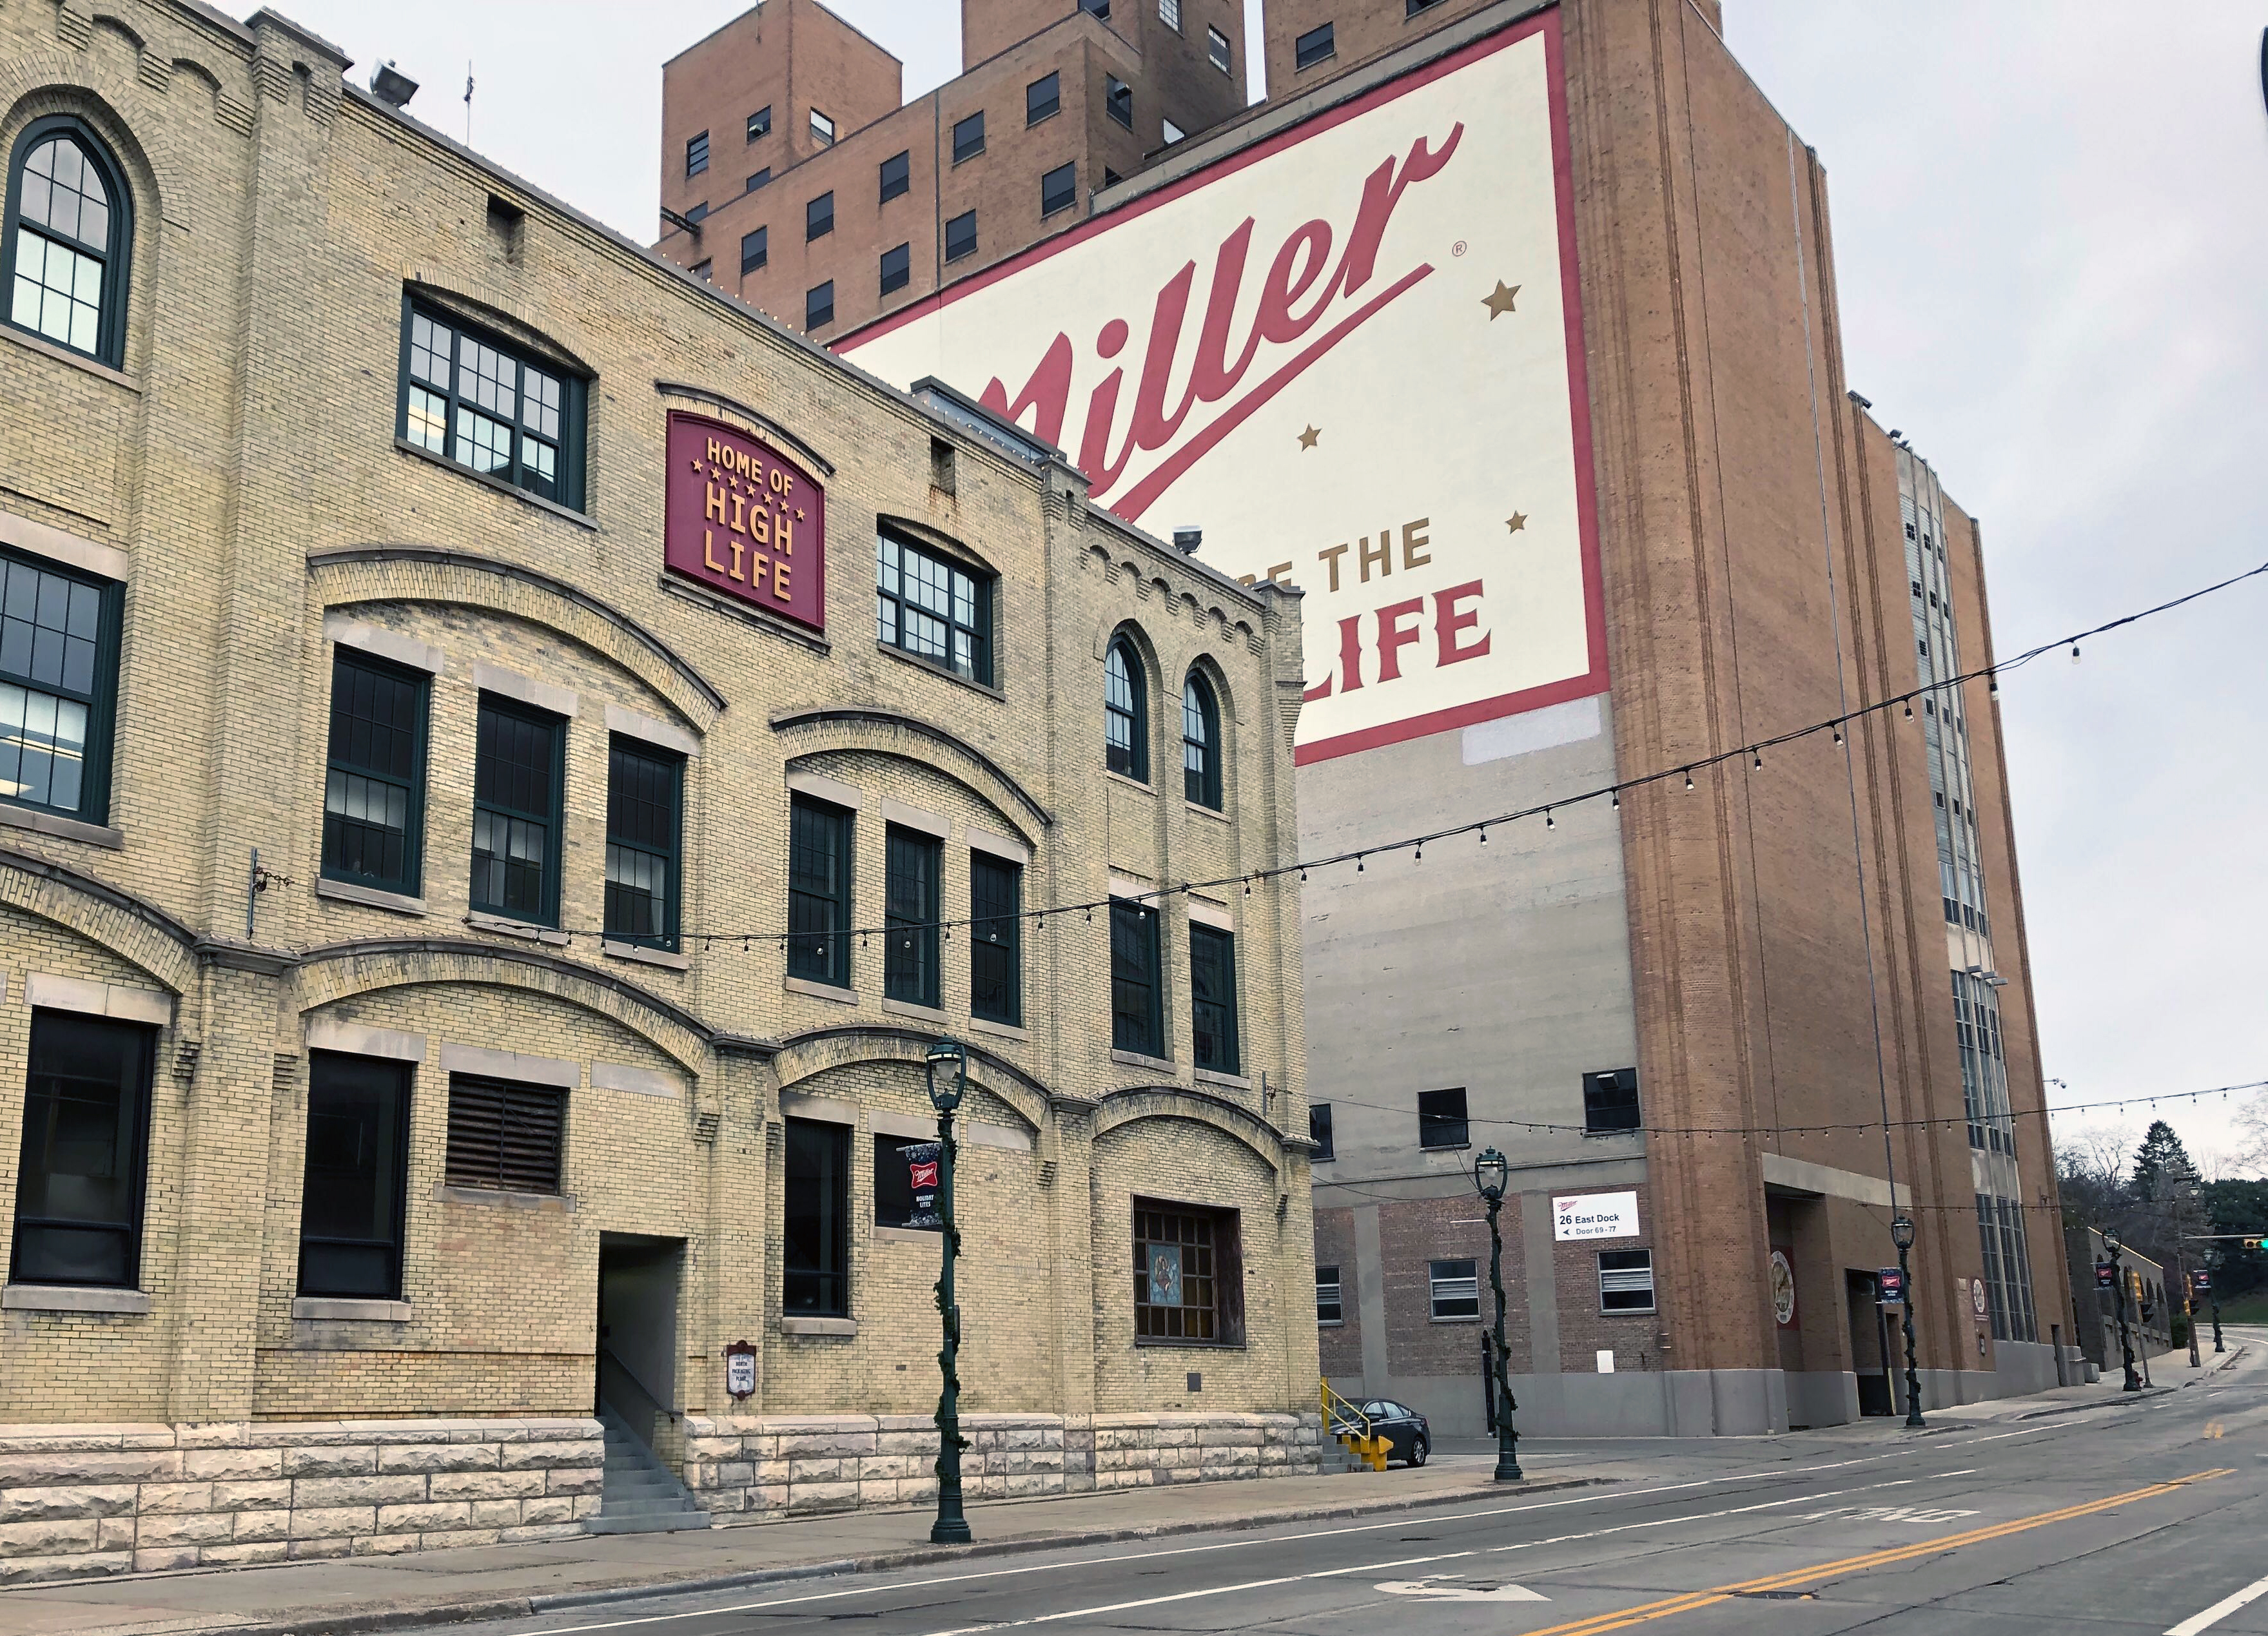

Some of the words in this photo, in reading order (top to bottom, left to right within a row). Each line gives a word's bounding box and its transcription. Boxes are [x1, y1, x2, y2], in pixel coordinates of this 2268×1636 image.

[707, 436, 763, 484] HOME
[770, 469, 794, 497] OF
[706, 482, 793, 556] HIGH
[704, 529, 792, 602] LIFE
[1319, 517, 1431, 592] THE
[914, 1168, 934, 1182] Miller
[1558, 1200, 1578, 1211] Miller
[1559, 1215, 1572, 1225] 26
[1597, 1214, 1619, 1222] Dock
